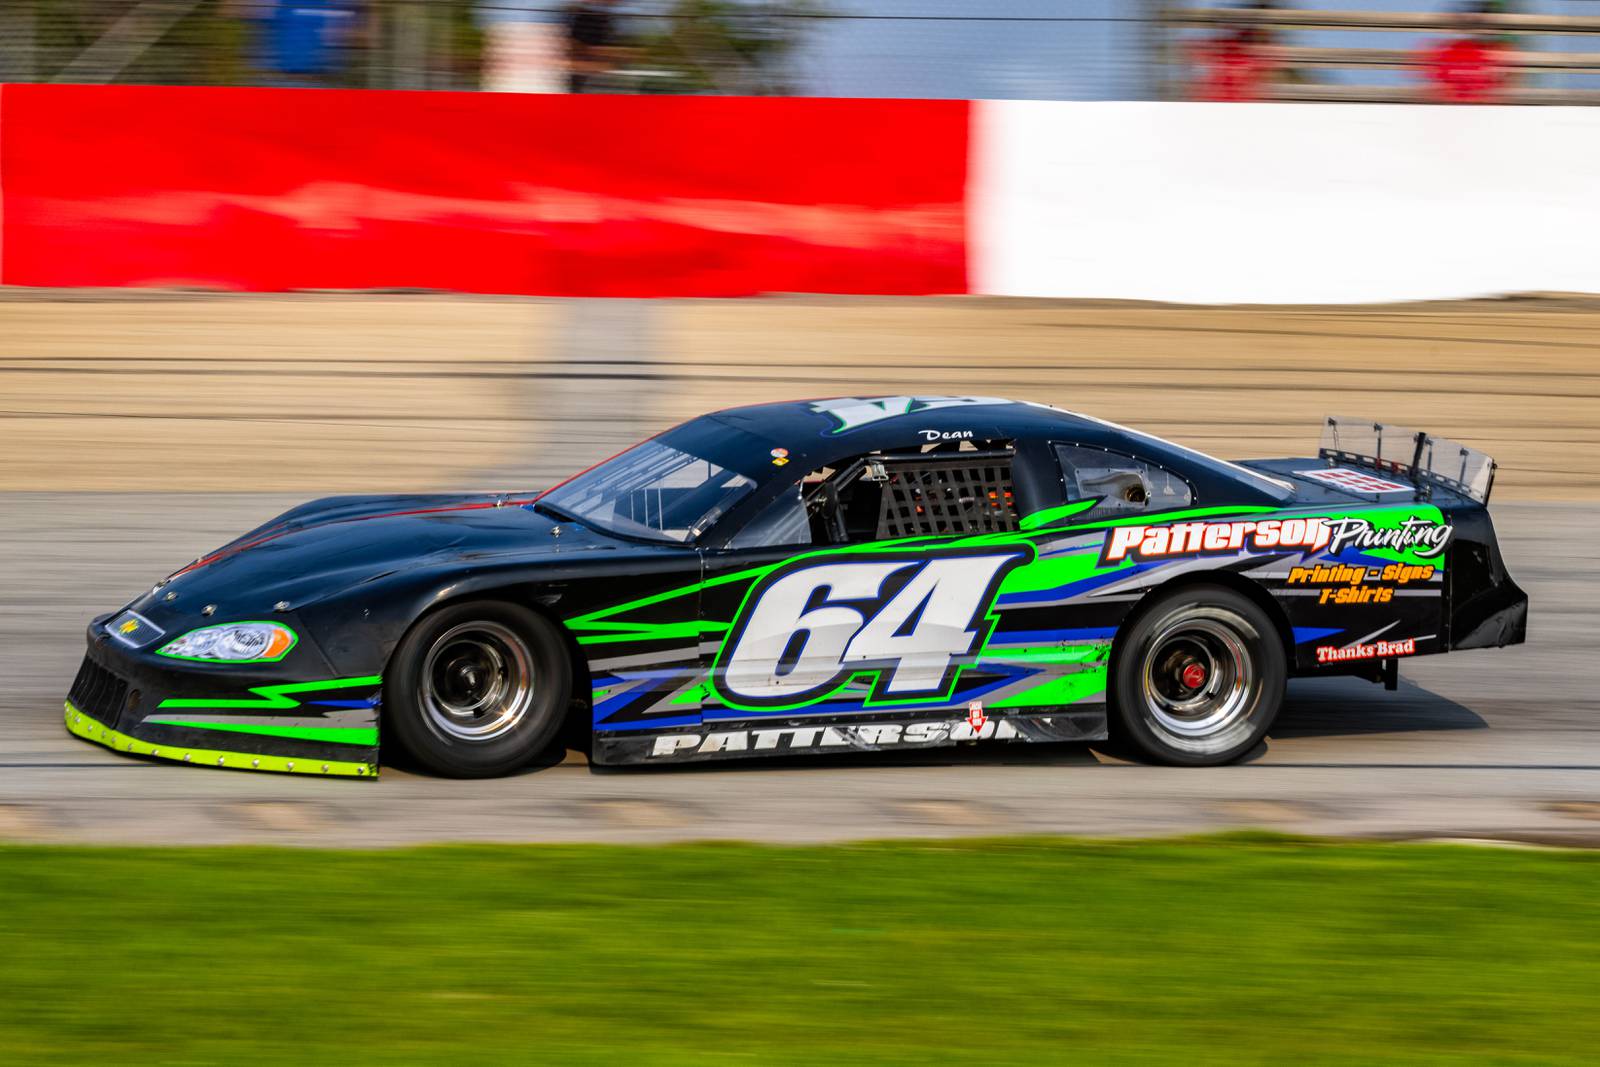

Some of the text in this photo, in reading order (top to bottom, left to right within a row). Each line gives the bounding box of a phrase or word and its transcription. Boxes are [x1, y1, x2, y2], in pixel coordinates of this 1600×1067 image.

[918, 429, 973, 441] Dean
[1105, 516, 1453, 558] Patterson Printing
[1287, 564, 1366, 585] Printing
[1381, 563, 1434, 583] Signs
[1319, 585, 1394, 604] T-Shirts
[724, 553, 1026, 698] 64
[1317, 639, 1415, 662] Thanks Brad
